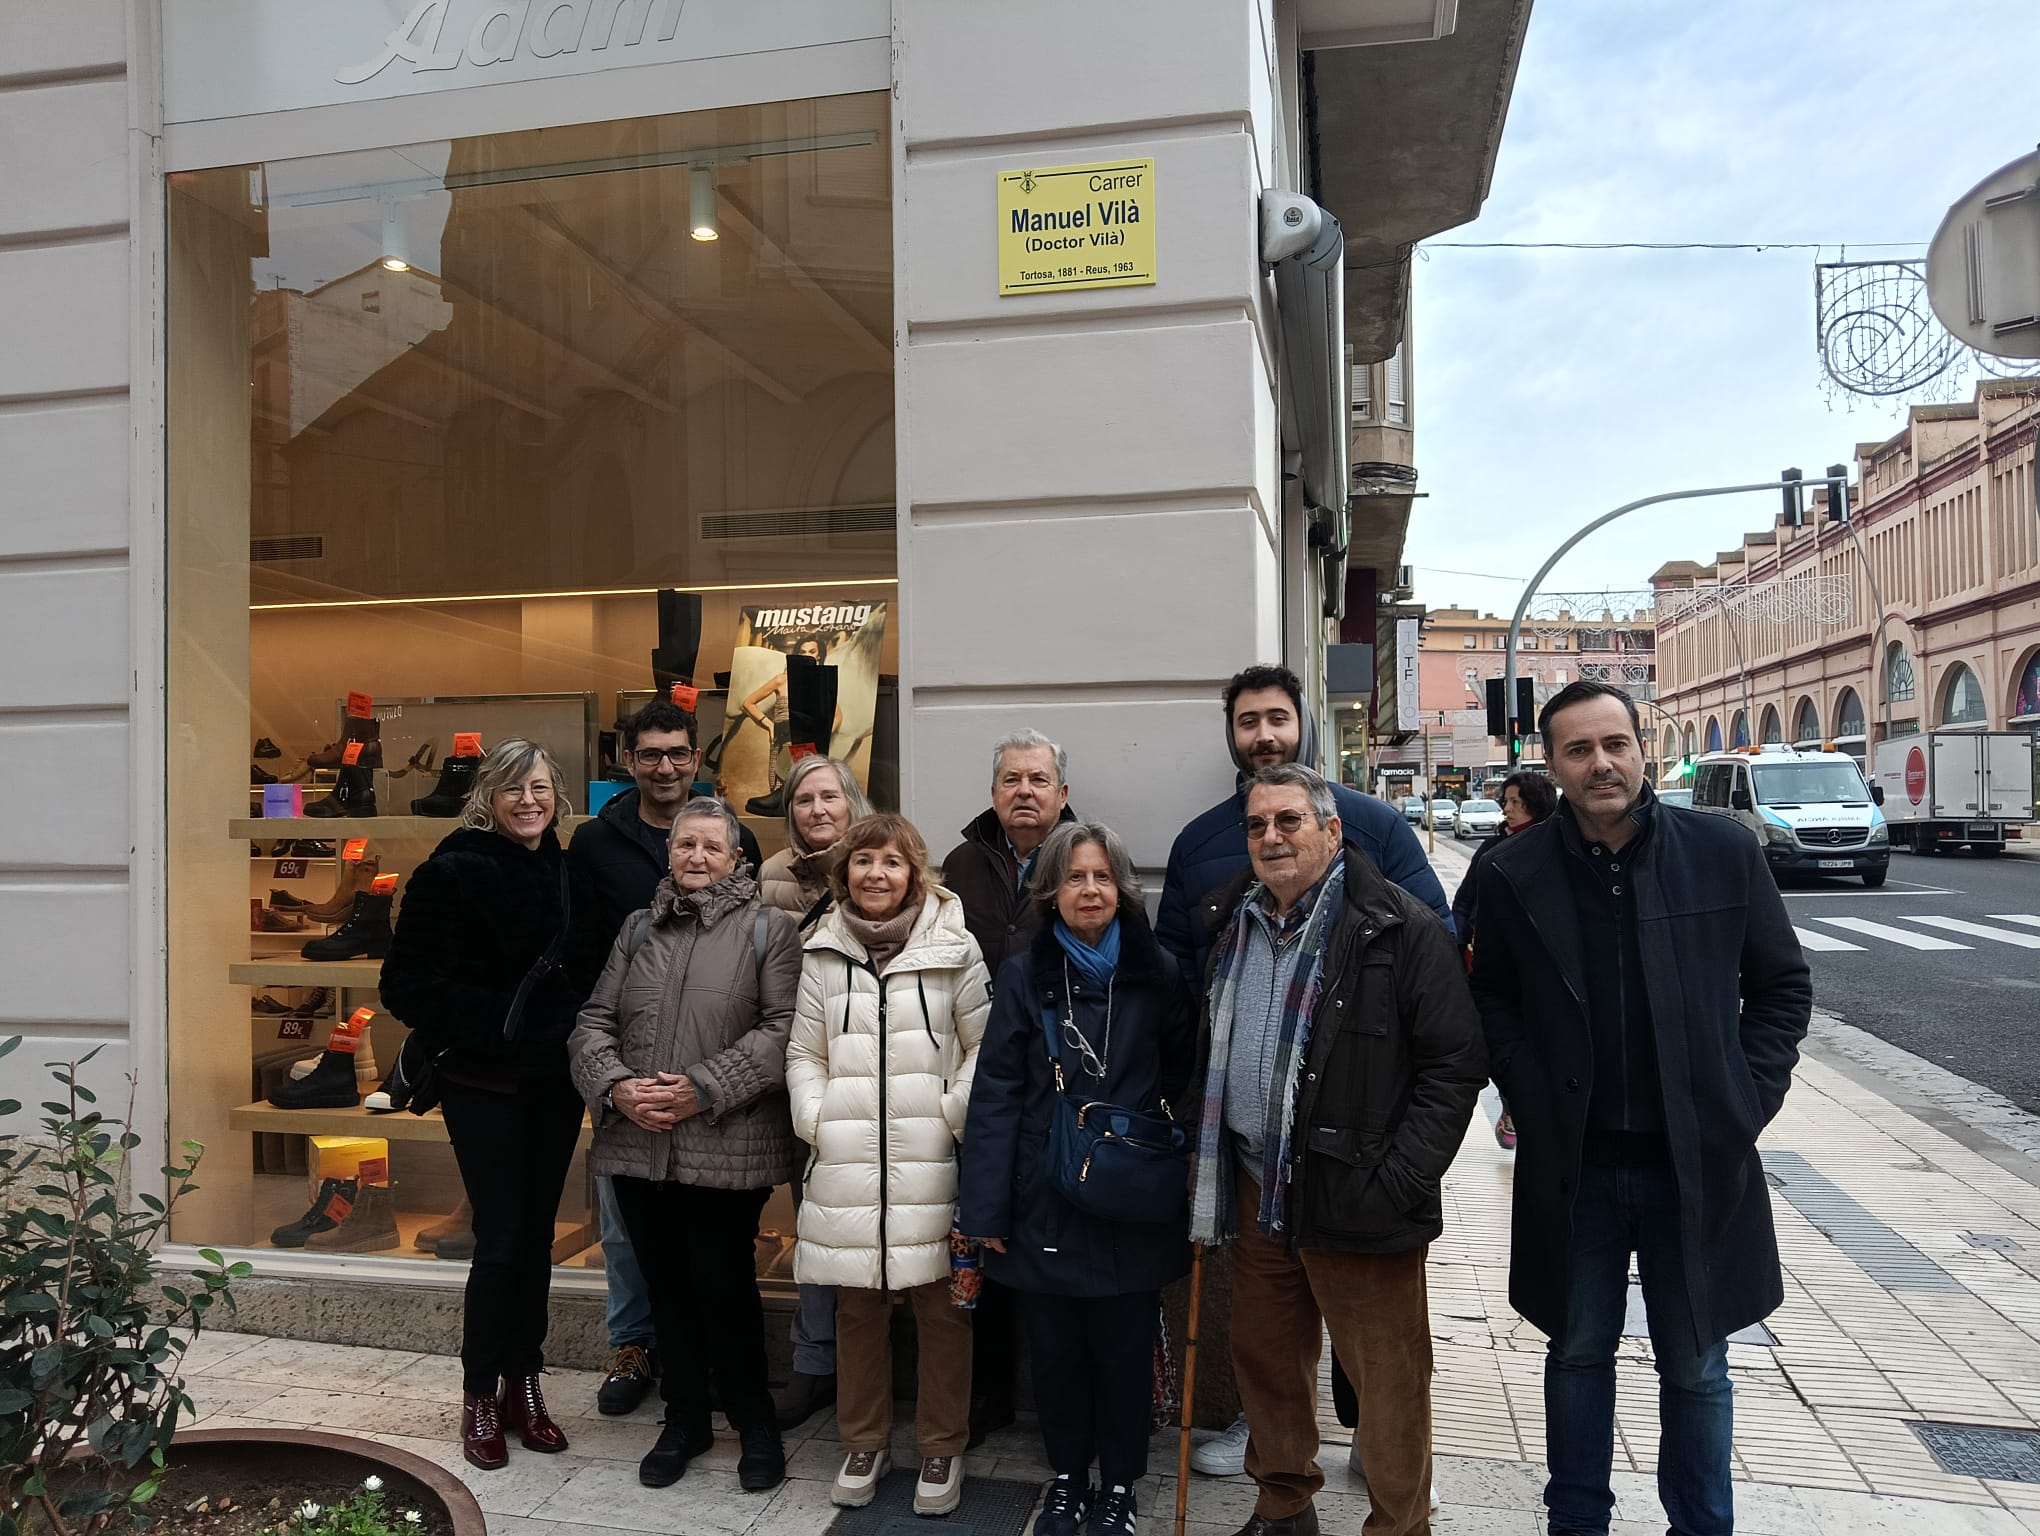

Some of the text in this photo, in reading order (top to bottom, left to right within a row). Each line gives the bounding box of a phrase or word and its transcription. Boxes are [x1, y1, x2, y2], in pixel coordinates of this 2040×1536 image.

[1089, 173, 1143, 192] Carrer
[1011, 198, 1140, 233] Manuel Vilà
[1025, 229, 1125, 253] (Doctor Vilà)
[1020, 270, 1055, 281] Tortosa,
[1057, 267, 1077, 278] 1881
[1085, 264, 1111, 275] Reus,
[1113, 261, 1133, 273] 1963
[755, 604, 871, 628] mustang
[1381, 768, 1415, 776] farmacia
